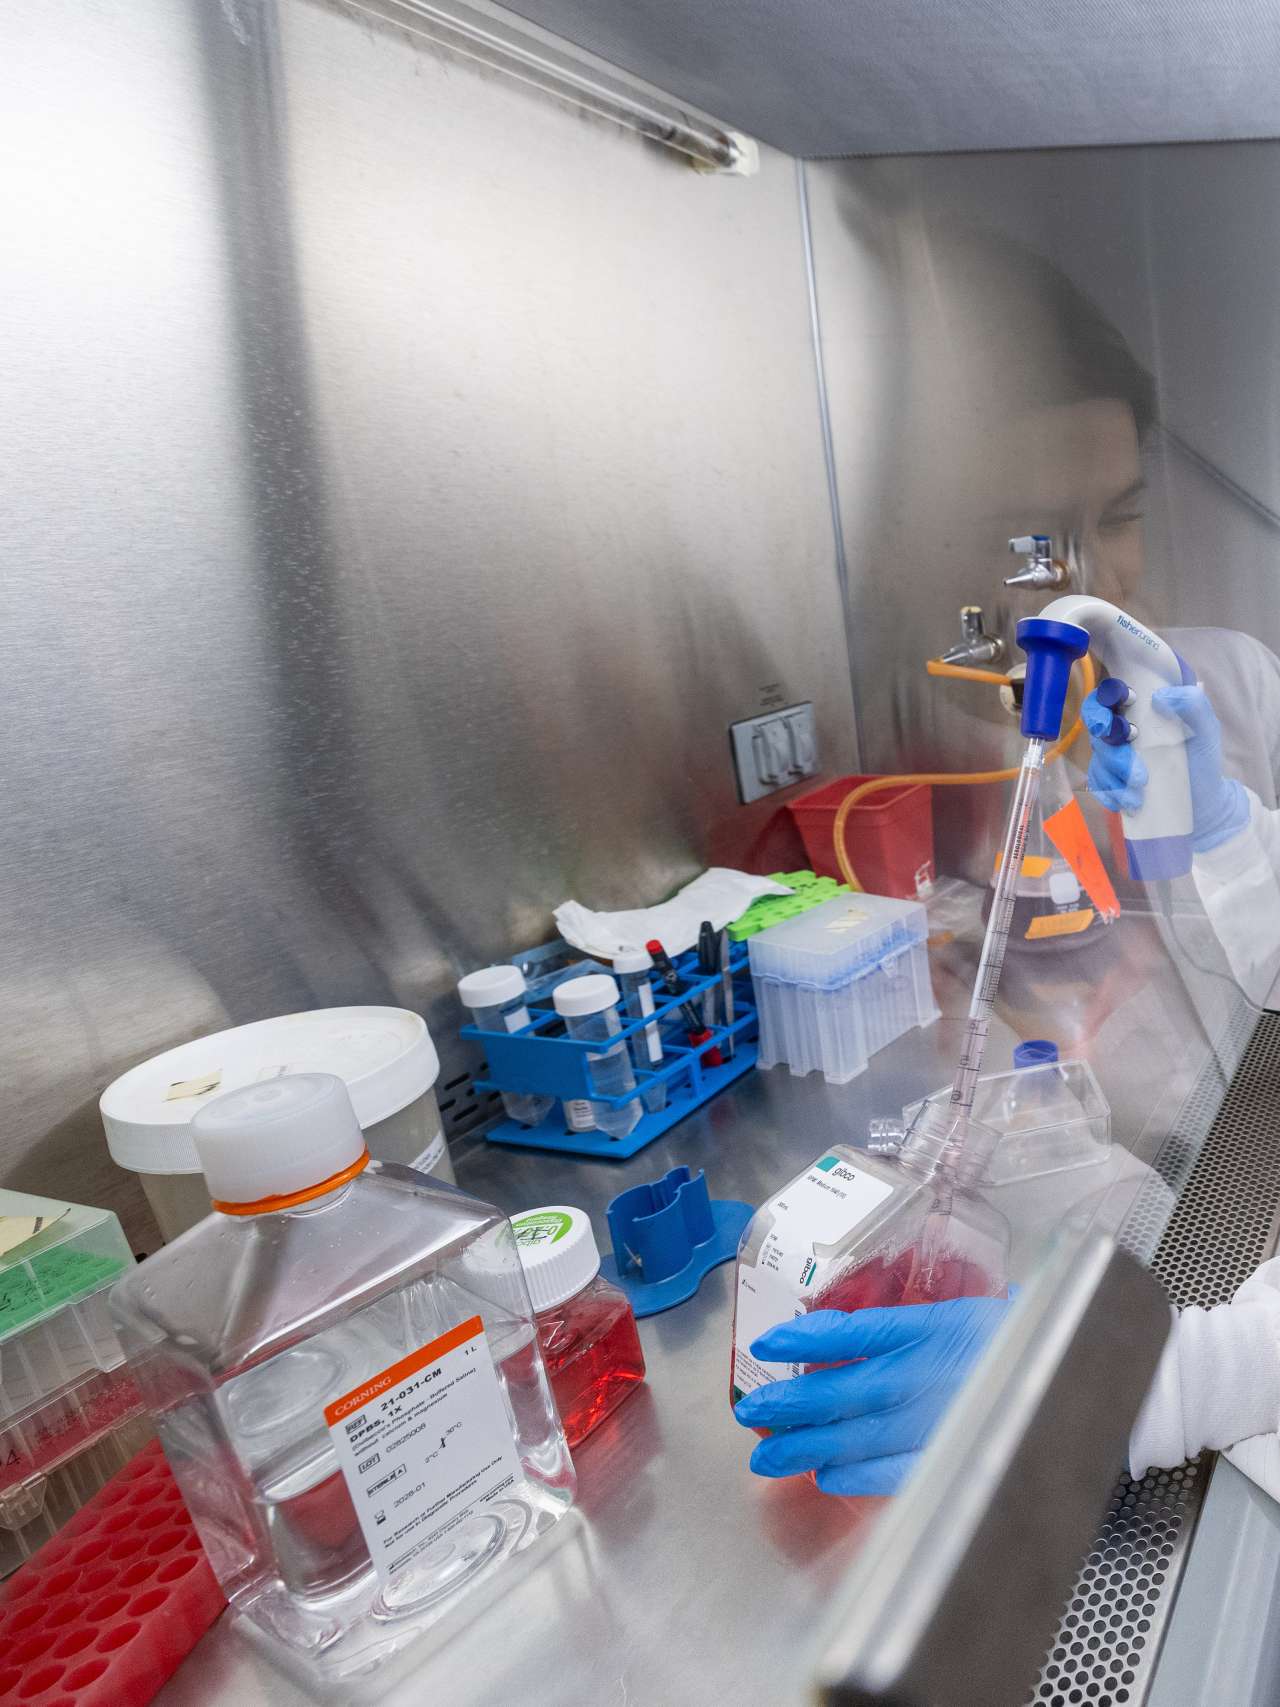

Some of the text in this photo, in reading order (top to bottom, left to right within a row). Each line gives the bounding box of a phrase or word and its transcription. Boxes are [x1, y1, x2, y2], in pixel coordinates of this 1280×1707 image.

[831, 1166, 856, 1182] gibco
[799, 1257, 812, 1285] gibco
[335, 1376, 392, 1416] CORNING
[381, 1368, 442, 1411] 21-031-CM
[349, 1405, 402, 1442] DPBS, 1X
